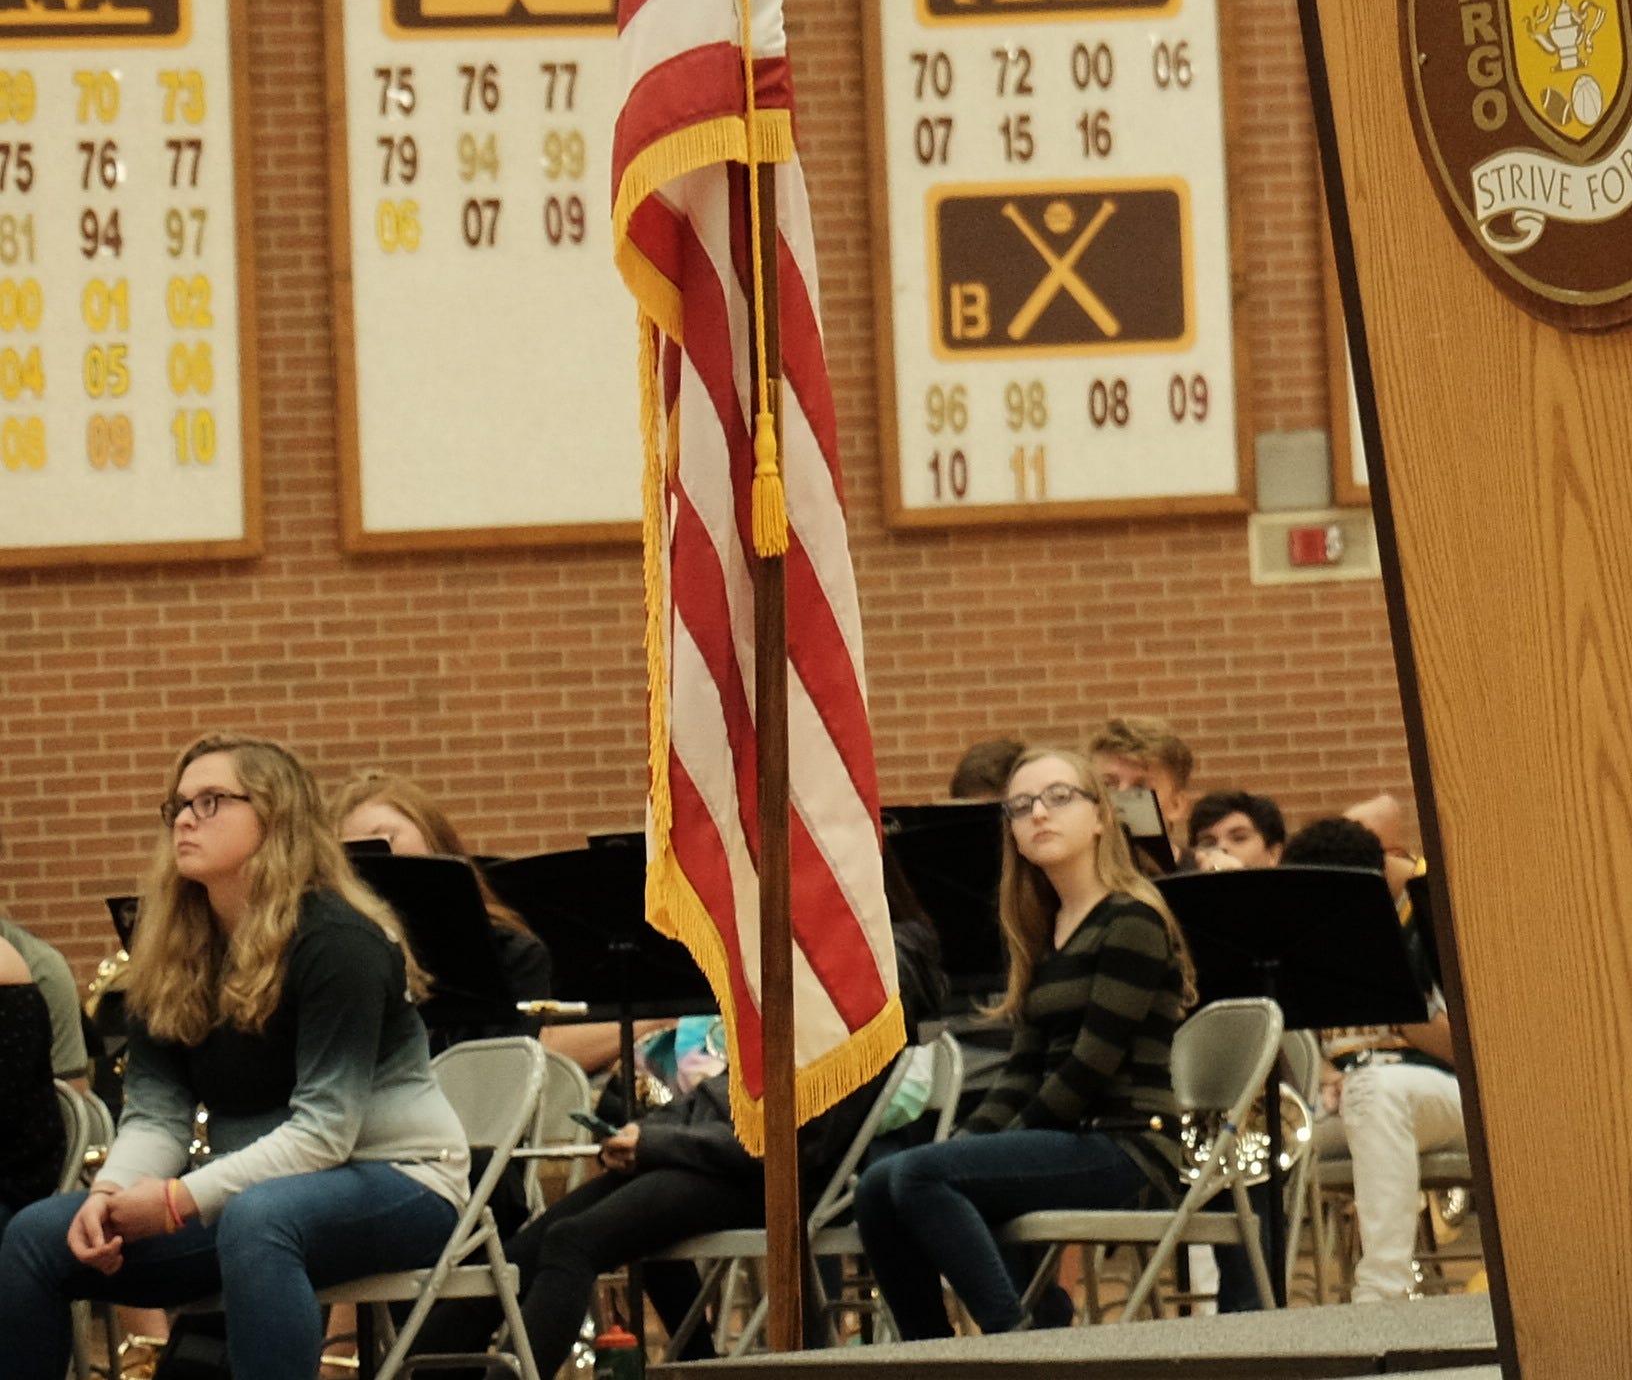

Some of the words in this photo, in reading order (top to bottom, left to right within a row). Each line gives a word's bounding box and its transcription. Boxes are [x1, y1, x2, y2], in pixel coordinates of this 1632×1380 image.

[72, 69, 120, 124] 70
[157, 69, 207, 124] 73
[375, 66, 416, 116] 75
[457, 63, 499, 112] 76
[541, 61, 578, 110] 77
[910, 51, 952, 99] 70
[991, 47, 1033, 97] 72
[1072, 41, 1113, 90] 00
[1153, 40, 1193, 88] 06
[0, 142, 34, 193] 75
[78, 139, 118, 190] 76
[165, 138, 202, 188] 77
[378, 135, 418, 185] 79
[458, 132, 500, 182] 94
[543, 129, 586, 180] 99
[914, 117, 952, 165] 07
[999, 114, 1034, 162] 15
[1077, 110, 1112, 158] 16
[1477, 163, 1573, 210] STRIVE
[80, 208, 122, 258] 94
[166, 207, 207, 258] 97
[376, 199, 421, 252] 06
[463, 197, 501, 247] 07
[545, 195, 586, 246] 09
[0, 276, 43, 333] 00
[82, 276, 129, 333] 01
[166, 272, 213, 329] 02
[950, 283, 990, 340] B
[0, 345, 45, 400] 04
[83, 343, 130, 399] 05
[924, 383, 969, 434] 96
[1005, 380, 1048, 431] 98
[1089, 378, 1129, 428] 08
[1169, 373, 1208, 423] 09
[171, 408, 216, 465] 10
[929, 448, 968, 499] 10
[1010, 446, 1046, 499] 11
